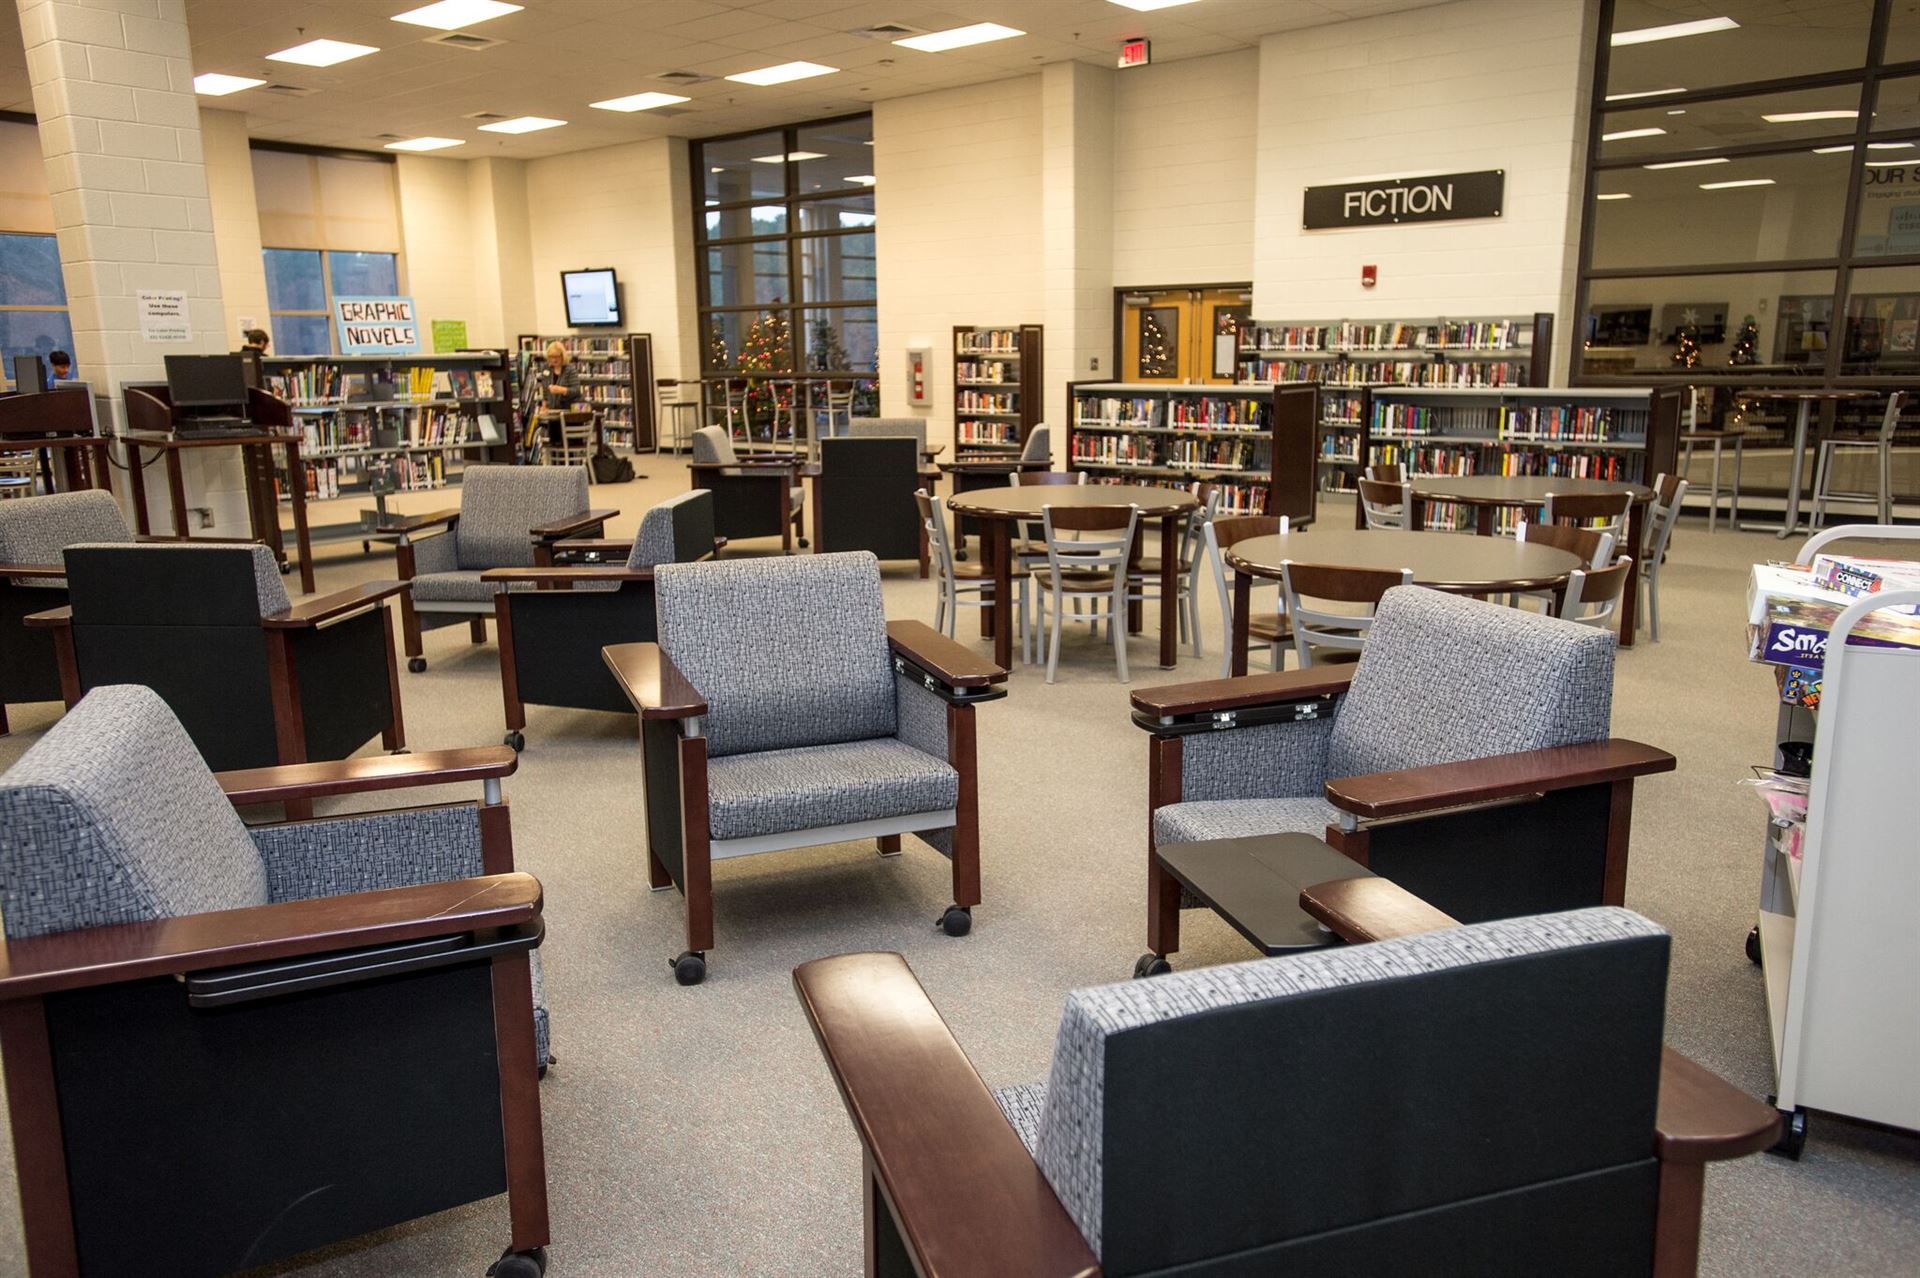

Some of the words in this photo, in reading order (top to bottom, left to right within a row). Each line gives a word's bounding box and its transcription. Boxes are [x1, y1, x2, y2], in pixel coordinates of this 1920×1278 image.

[1344, 184, 1453, 218] FICTION
[340, 302, 411, 322] GRAPHIC
[347, 327, 415, 346] NOVELS
[1836, 572, 1872, 591] CONNECT
